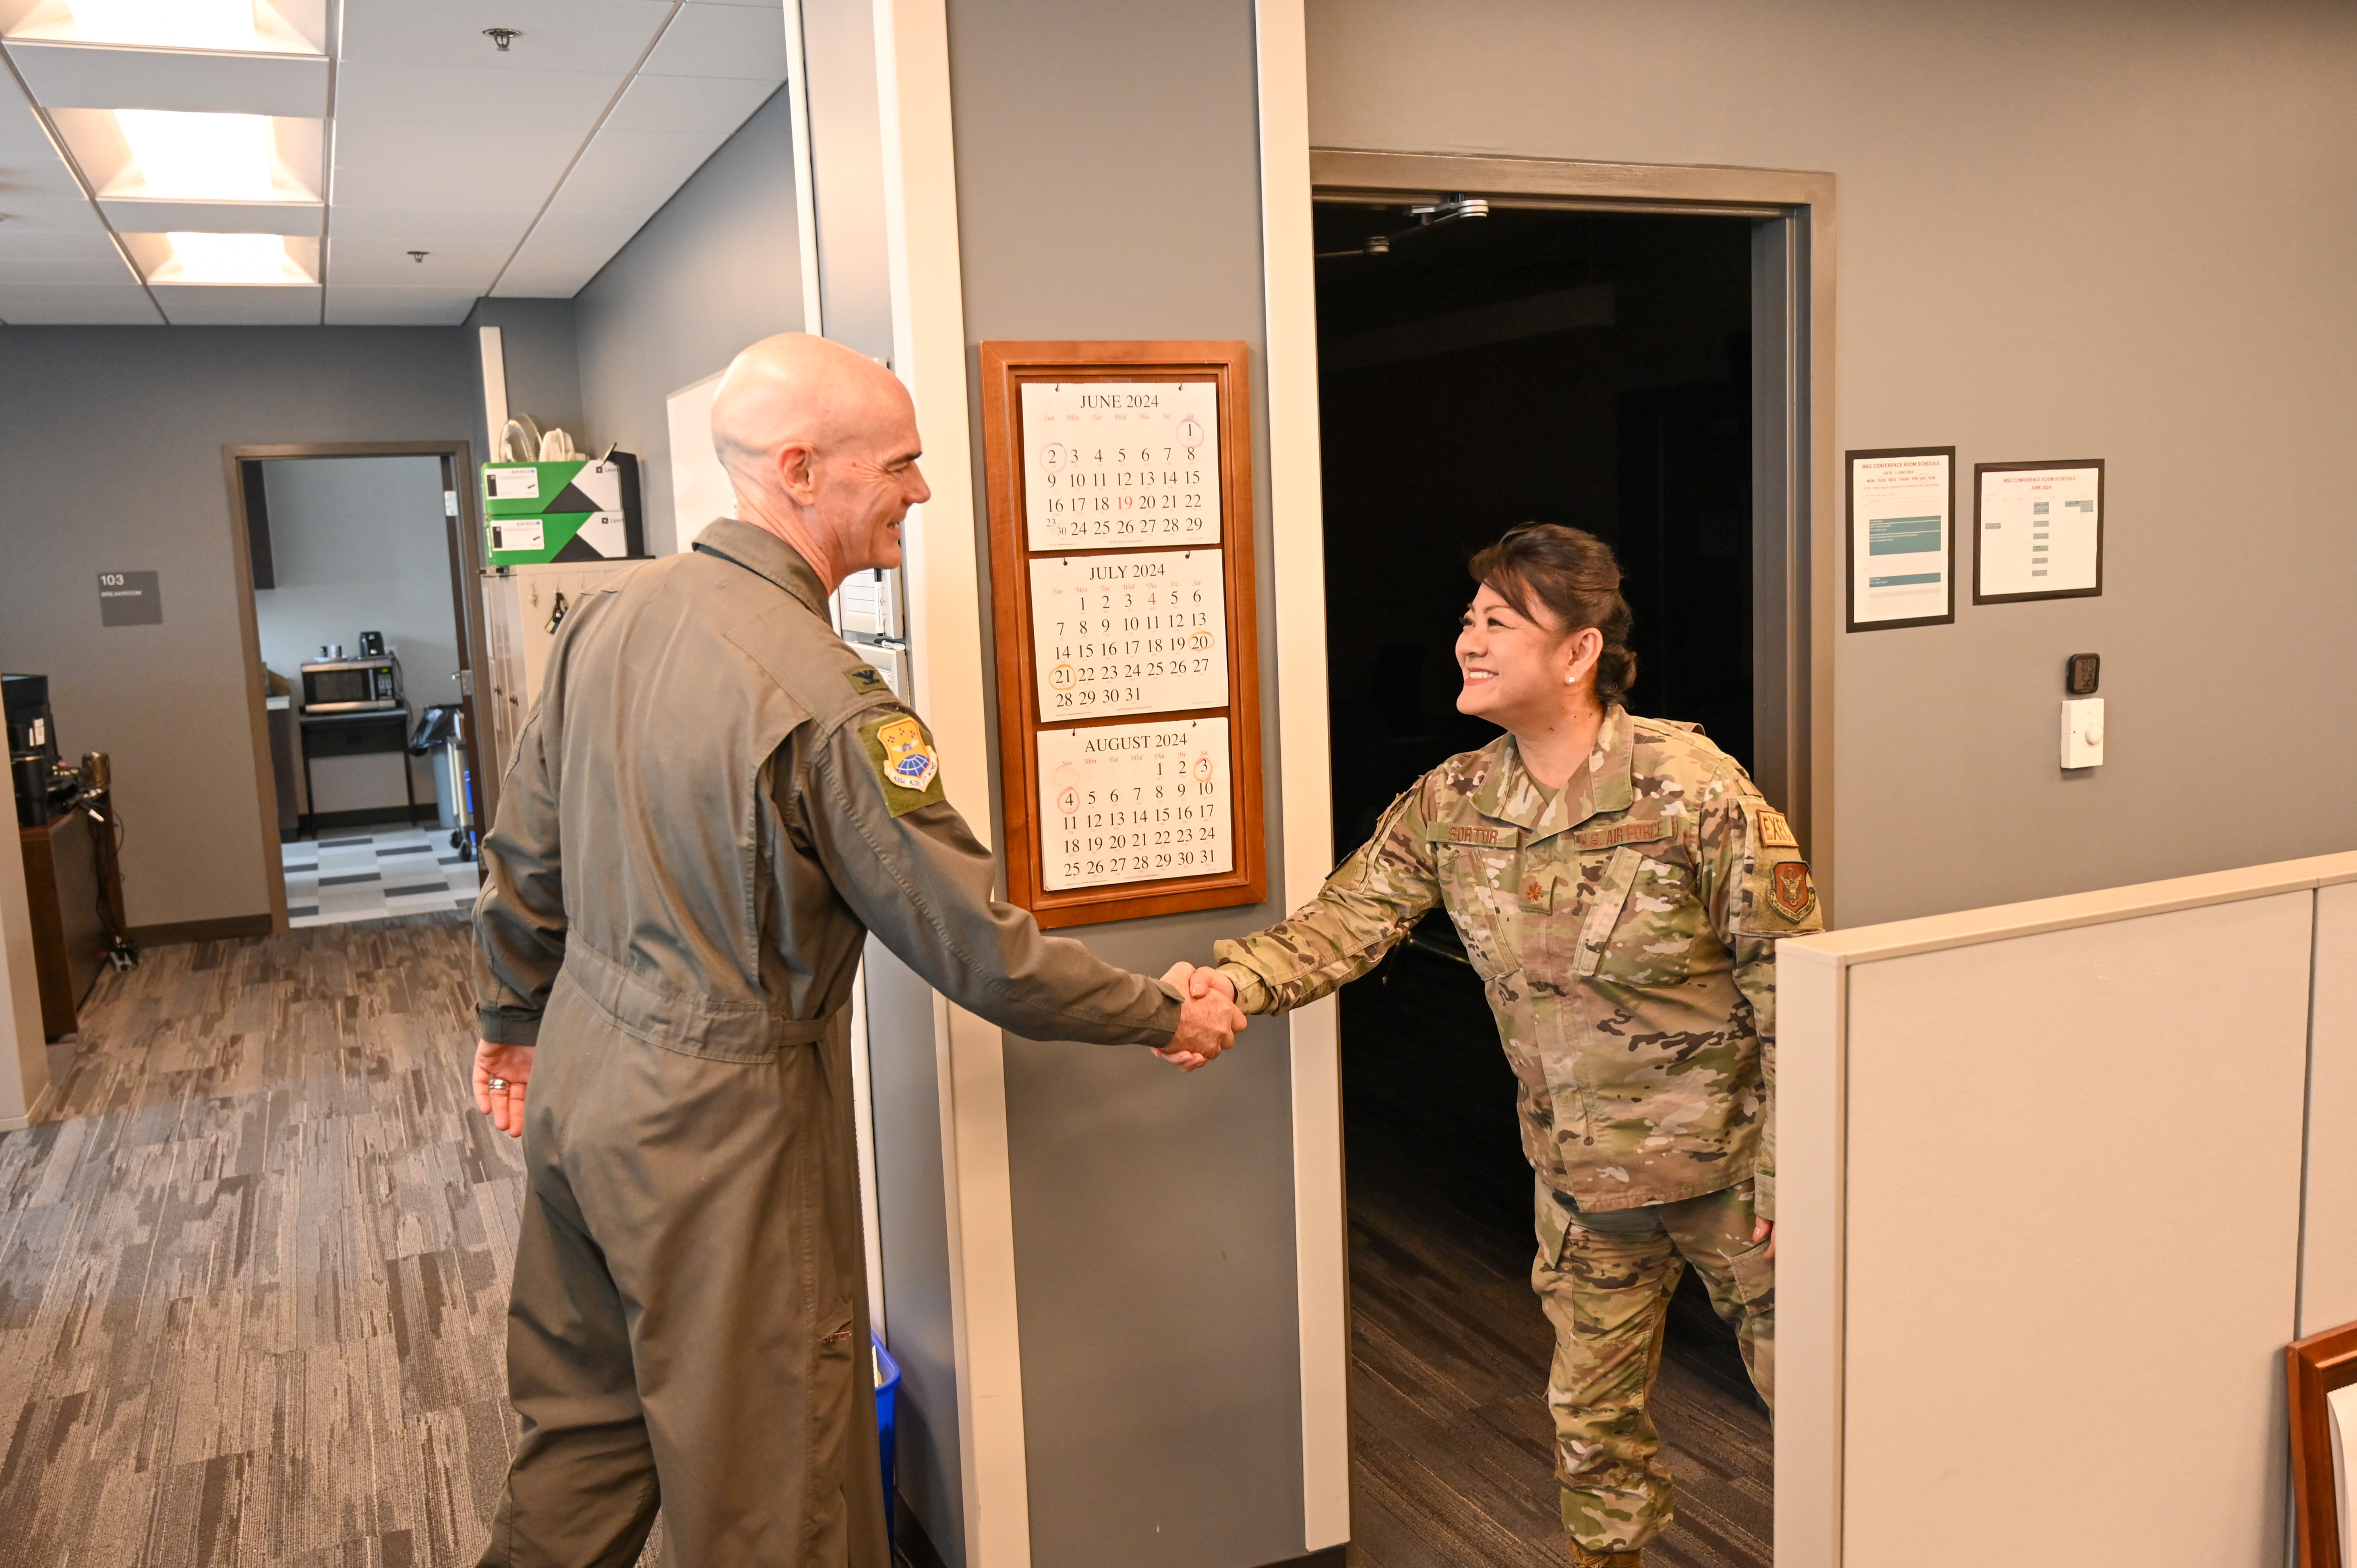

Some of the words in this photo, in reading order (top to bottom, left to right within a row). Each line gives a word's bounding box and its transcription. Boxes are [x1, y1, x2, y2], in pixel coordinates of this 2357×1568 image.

[1080, 395, 1122, 408] JUNE
[1126, 395, 1159, 408] 2024
[1188, 424, 1192, 436] 1
[1048, 450, 1056, 463] 2
[1071, 449, 1078, 463] 3
[1094, 449, 1103, 462] 4
[1118, 449, 1126, 462] 5
[1141, 448, 1150, 461] 6
[1163, 447, 1171, 461] 7
[1188, 447, 1195, 460] 8
[1048, 474, 1056, 487] 9
[1071, 474, 1085, 487] 10
[1094, 473, 1105, 486] 11
[1117, 472, 1132, 486] 12
[1140, 472, 1155, 485] 13
[1163, 471, 1177, 484] 14
[1186, 471, 1200, 484] 15
[1049, 499, 1064, 512] 16
[1072, 498, 1085, 511] 17
[1095, 497, 1109, 511] 18
[1118, 496, 1133, 510] 19
[1139, 496, 1155, 509] 20
[1162, 495, 1176, 509] 21
[1185, 494, 1201, 508] 22
[1071, 522, 1087, 536] 24
[1094, 521, 1110, 535] 25
[1117, 520, 1134, 534] 26
[1140, 519, 1156, 533] 27
[1163, 519, 1179, 532] 28
[1186, 517, 1202, 531] 29
[101, 574, 124, 585] 103
[1089, 565, 1128, 580] JULY
[1132, 563, 1165, 578] 2024
[1081, 597, 1085, 610] 1
[1102, 595, 1110, 609] 2
[1125, 594, 1132, 607] 3
[1148, 592, 1157, 606] 4
[1171, 591, 1178, 604] 5
[1193, 590, 1201, 603] 6
[1057, 622, 1064, 636] 7
[1080, 621, 1087, 634] 8
[1101, 619, 1110, 632] 9
[1124, 617, 1139, 631] 10
[1147, 616, 1159, 629] 11
[1170, 614, 1184, 628] 12
[1192, 612, 1206, 626] 13
[1056, 645, 1071, 660] 14
[1079, 644, 1093, 658] 15
[1102, 642, 1117, 656] 16
[1126, 640, 1139, 654] 17
[1148, 639, 1163, 653] 18
[1171, 637, 1185, 651] 19
[1192, 635, 1208, 649] 20
[1055, 669, 1070, 684] 21
[1078, 667, 1095, 682] 22
[1101, 665, 1117, 680] 23
[1124, 664, 1141, 678] 24
[1147, 662, 1163, 676] 25
[1169, 660, 1186, 674] 26
[1192, 658, 1209, 672] 27
[1056, 693, 1072, 707] 28
[1079, 691, 1096, 705] 29
[1103, 689, 1119, 703] 30
[1125, 687, 1140, 701] 31
[1084, 735, 1151, 753] AUGUST
[1155, 733, 1187, 747] 2024
[1158, 763, 1163, 776] 1
[1178, 761, 1186, 774] 2
[1201, 759, 1208, 772] 3
[1065, 793, 1074, 806] 4
[1088, 791, 1096, 805] 5
[1110, 789, 1118, 803] 6
[1133, 787, 1141, 801] 7
[1156, 785, 1163, 798] 8
[1177, 784, 1186, 797] 9
[1199, 782, 1213, 795] 10
[1064, 816, 1076, 830] 11
[1088, 814, 1102, 828] 12
[1111, 812, 1125, 826] 13
[1134, 810, 1148, 824] 14
[1156, 808, 1169, 821] 15
[1178, 806, 1192, 819] 16
[1200, 804, 1214, 818] 17
[1449, 826, 1498, 844] SORTOR
[1580, 833, 1603, 849] U.S.
[1606, 828, 1623, 845] AIR
[1626, 820, 1664, 840] FORCE
[1763, 815, 1792, 842] EXEC
[1066, 839, 1080, 853] 18
[1088, 837, 1103, 851] 19
[1109, 835, 1126, 849] 20
[1132, 833, 1146, 847] 21
[1154, 831, 1171, 845] 22
[1176, 829, 1192, 843] 23
[1199, 827, 1215, 840] 24
[1064, 862, 1080, 877] 25
[1086, 860, 1104, 874] 26
[1110, 858, 1126, 872] 27
[1132, 856, 1149, 870] 28
[1155, 853, 1171, 867] 29
[1178, 851, 1194, 865] 30
[1200, 849, 1214, 863] 31
